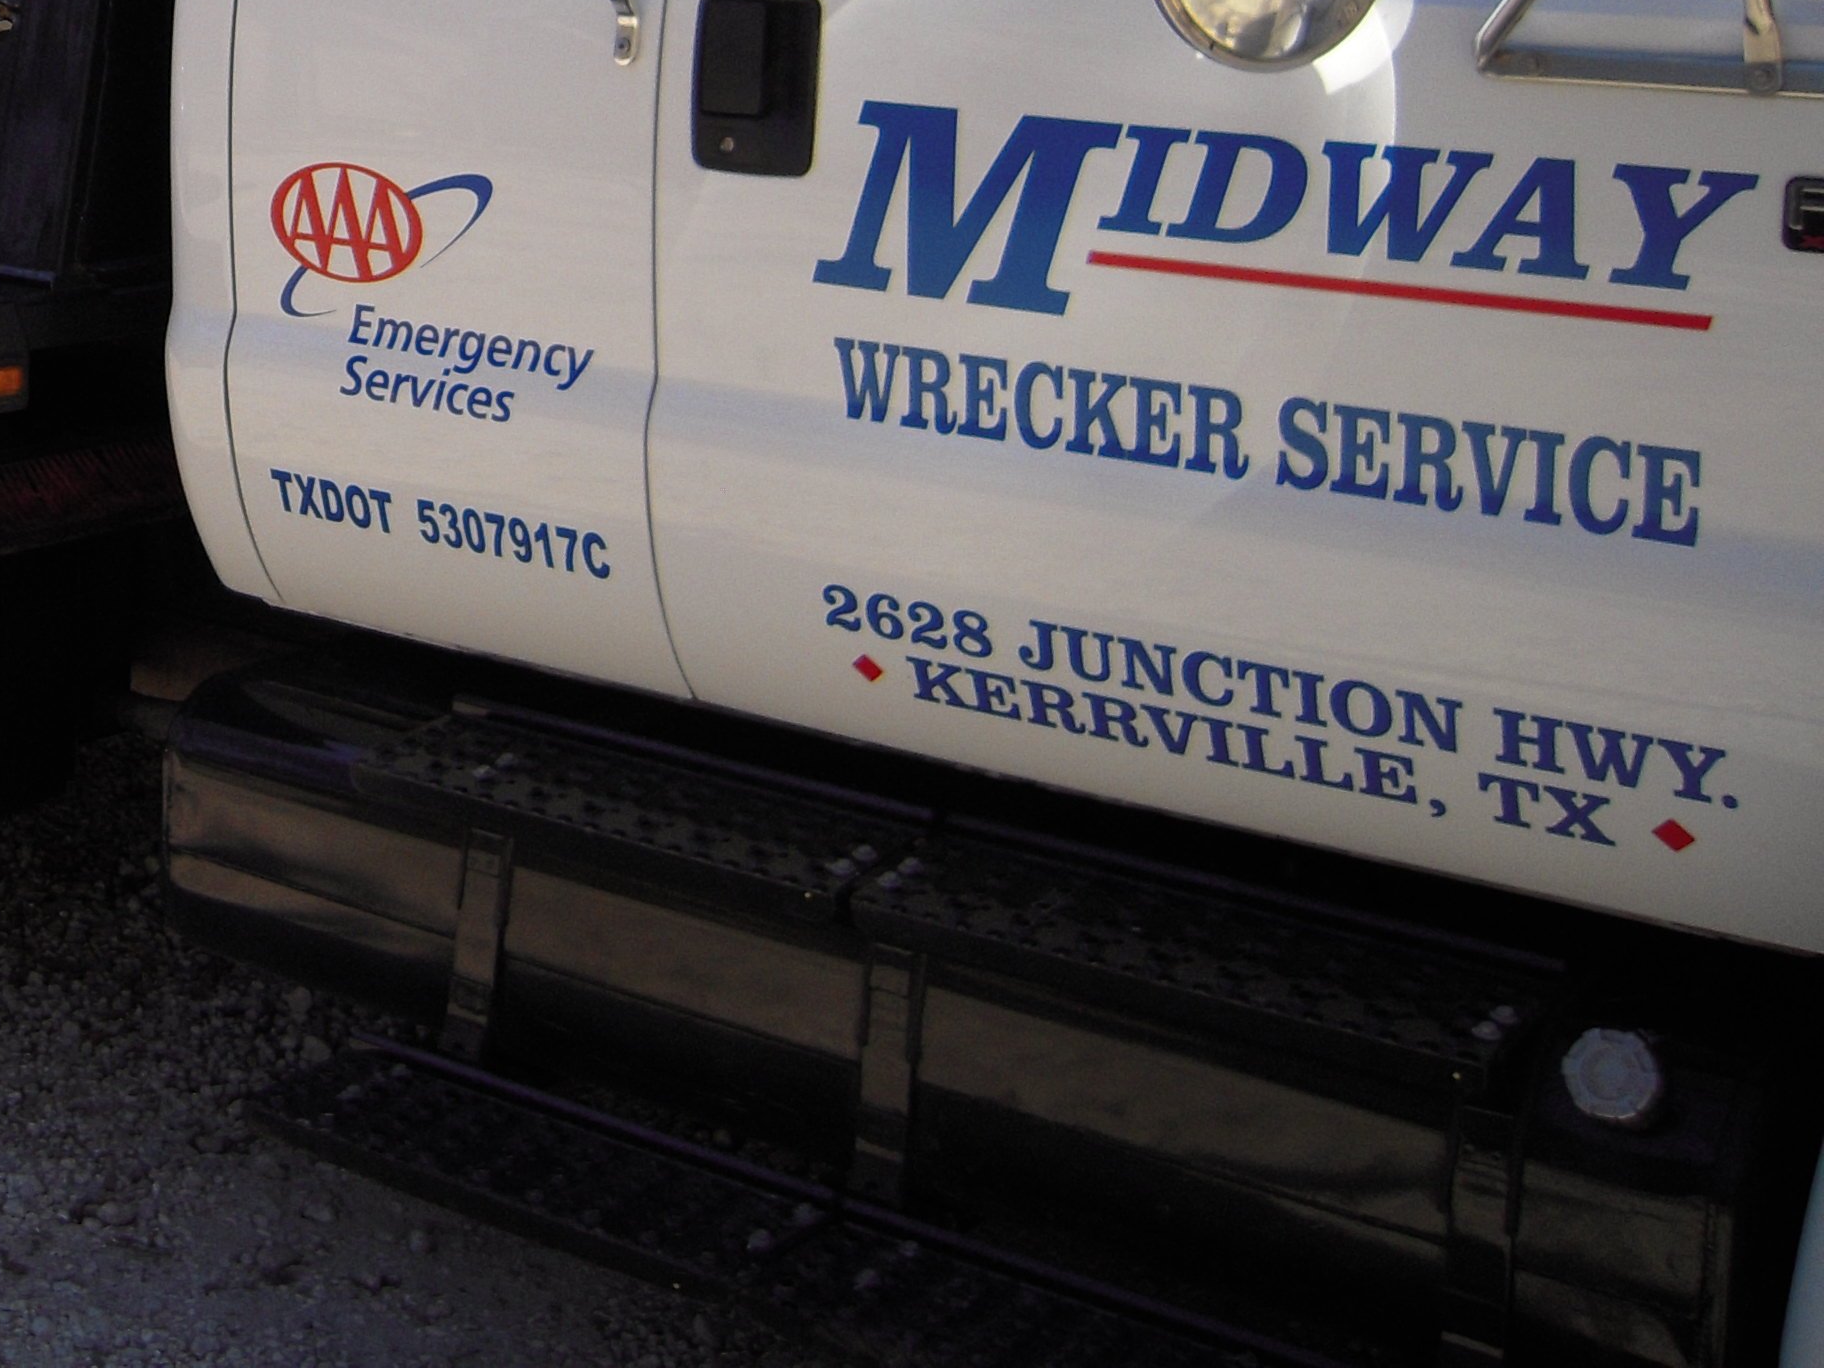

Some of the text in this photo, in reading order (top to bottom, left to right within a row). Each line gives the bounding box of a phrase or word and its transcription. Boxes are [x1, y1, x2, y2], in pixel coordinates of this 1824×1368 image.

[280, 164, 414, 282] AAA
[812, 100, 1759, 316] MIDWAY
[339, 356, 515, 422] Services
[347, 304, 595, 391] Emergency
[833, 337, 1702, 548] WRECKER SERVICE
[270, 469, 611, 580] TXDOT 5307917C
[821, 584, 1740, 810] 2628 JUNCTION HWY.
[906, 657, 1617, 847] KERRVILLE, TX
